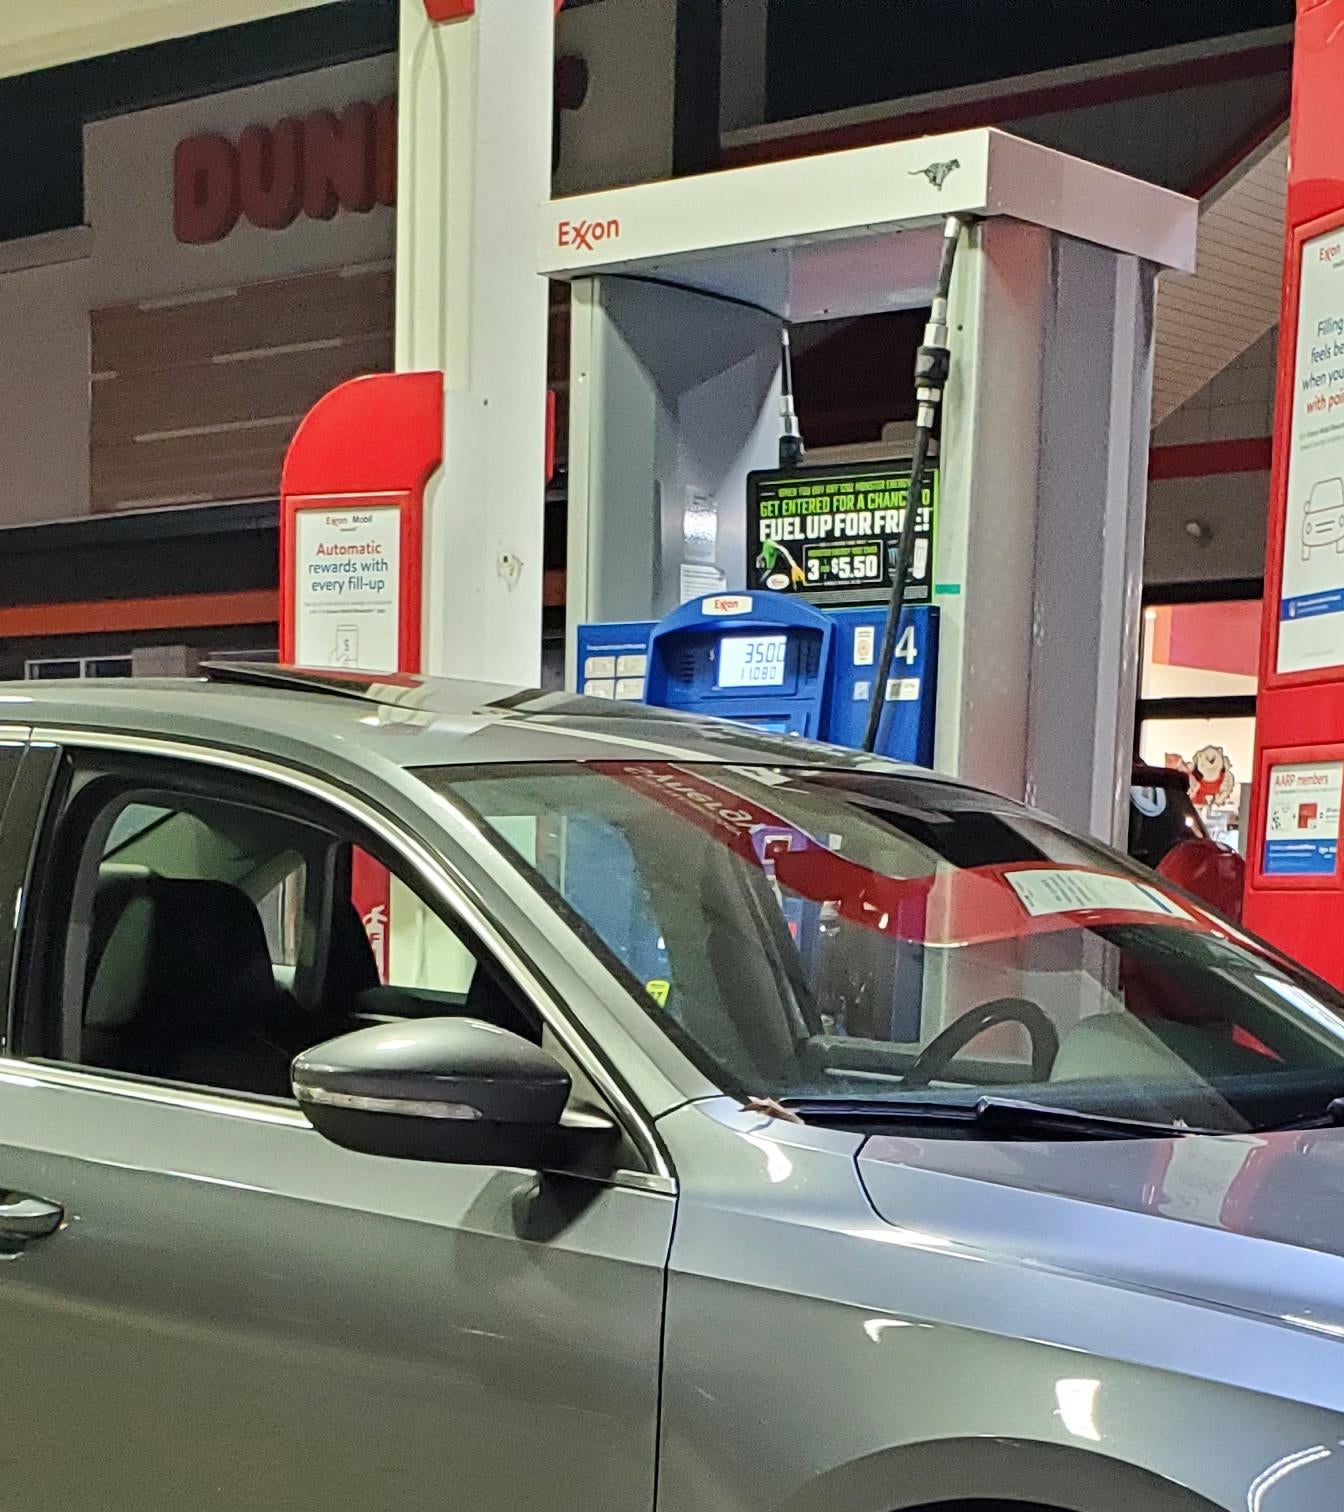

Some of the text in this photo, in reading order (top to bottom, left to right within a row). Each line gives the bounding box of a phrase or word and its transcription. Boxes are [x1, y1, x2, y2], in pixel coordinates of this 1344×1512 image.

[558, 219, 620, 251] Exxon
[1317, 316, 1344, 338] Filling
[1311, 345, 1332, 364] feels
[1302, 371, 1327, 391] when
[1327, 369, 1344, 388] you
[1306, 393, 1327, 414] with
[760, 500, 781, 517] GET
[782, 497, 830, 516] ENTERED
[833, 494, 855, 512] FOR
[857, 493, 864, 509] A
[868, 490, 908, 508] CHANC
[760, 517, 805, 542] FUEL
[807, 514, 832, 539] UP
[834, 511, 873, 537] FOR
[316, 540, 382, 556] Automatic
[308, 557, 389, 574] rewards with
[807, 555, 878, 581] 3 $5.50
[311, 575, 385, 595] every fill-up
[714, 598, 740, 611] Exxon
[895, 626, 918, 665] 4
[1297, 771, 1329, 786] members
